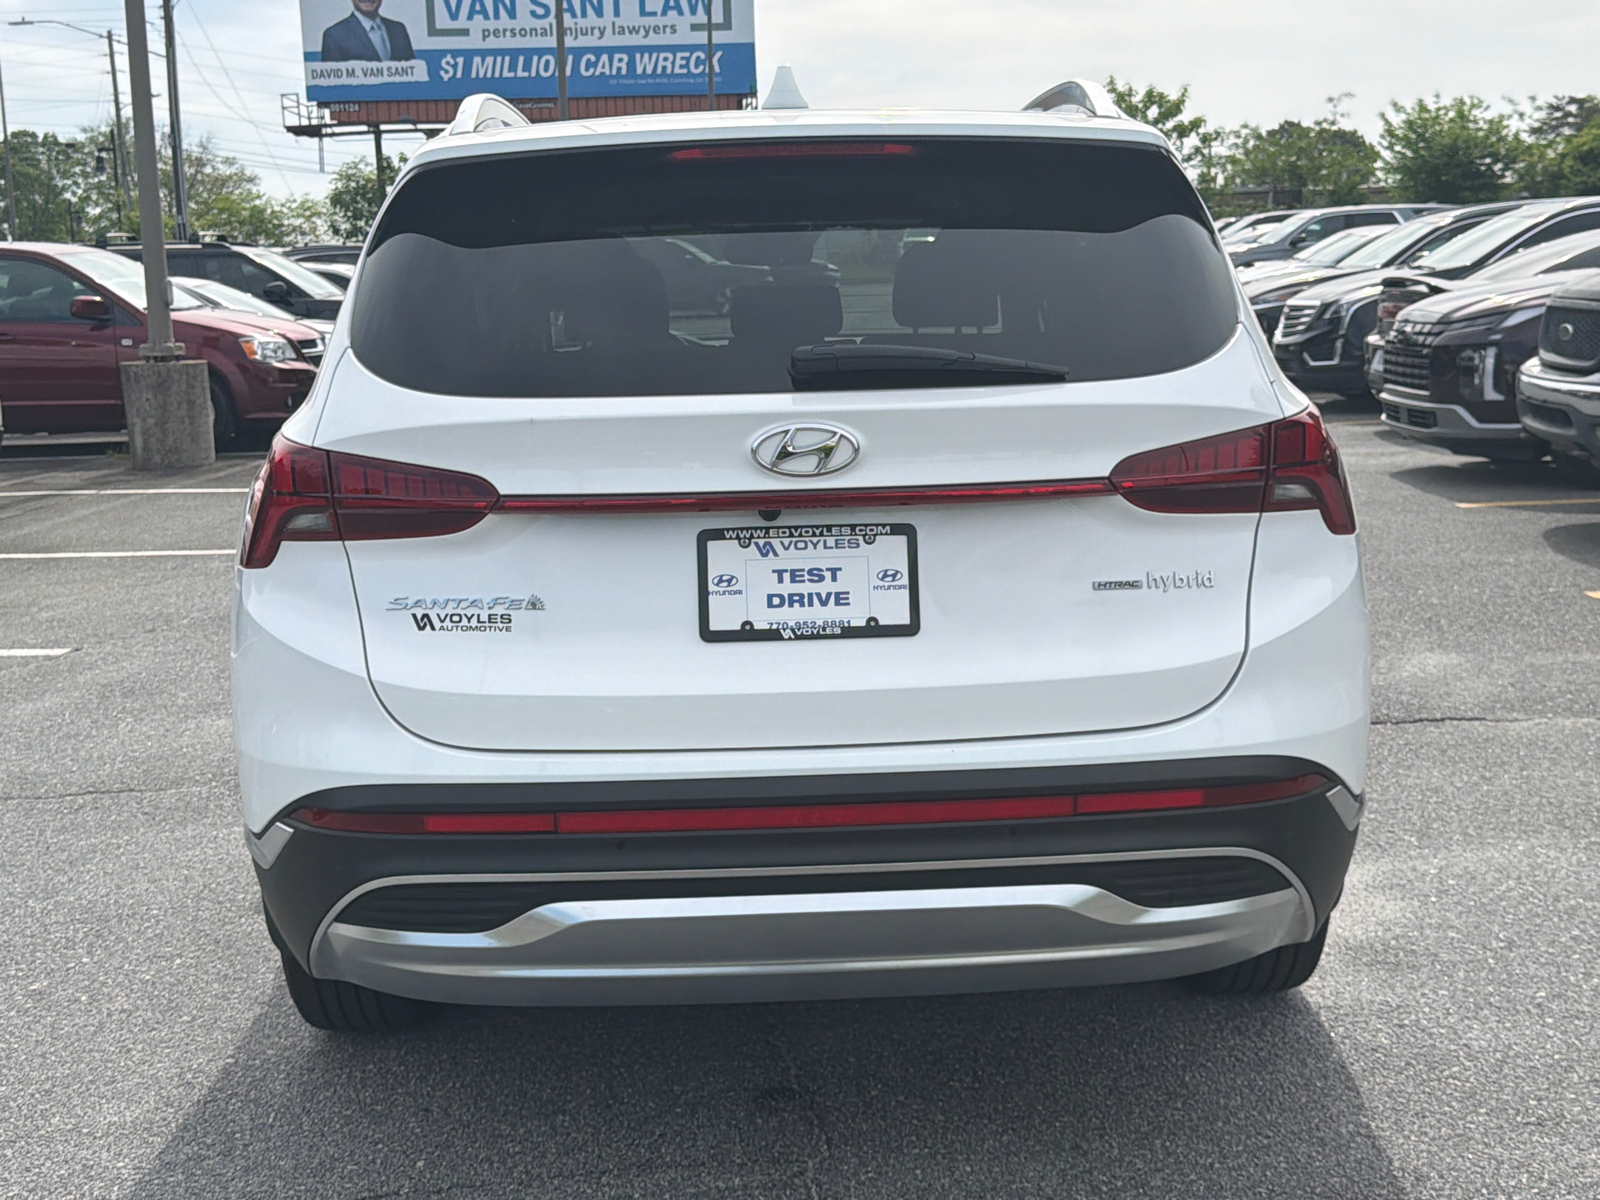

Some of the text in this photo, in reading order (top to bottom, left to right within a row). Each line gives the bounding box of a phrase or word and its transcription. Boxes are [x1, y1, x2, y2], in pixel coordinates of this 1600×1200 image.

[443, 0, 517, 21] VAN
[482, 20, 678, 42] personal njury lawyers
[311, 66, 416, 80] DAVID M. VAN SANT
[439, 54, 464, 82] $1
[579, 53, 629, 77] CAR
[634, 51, 723, 76] WRECK
[779, 538, 861, 551] VOYLES
[772, 567, 842, 584] TEST
[1097, 569, 1215, 593] HTRAC hybrid
[386, 596, 484, 611] SANTA
[766, 591, 851, 609] DRIVE
[436, 612, 512, 625] VOYLES
[767, 620, 852, 630] 770-952-8881
[438, 624, 512, 633] AUTOMOTIVE
[795, 627, 842, 636] VOYLES
